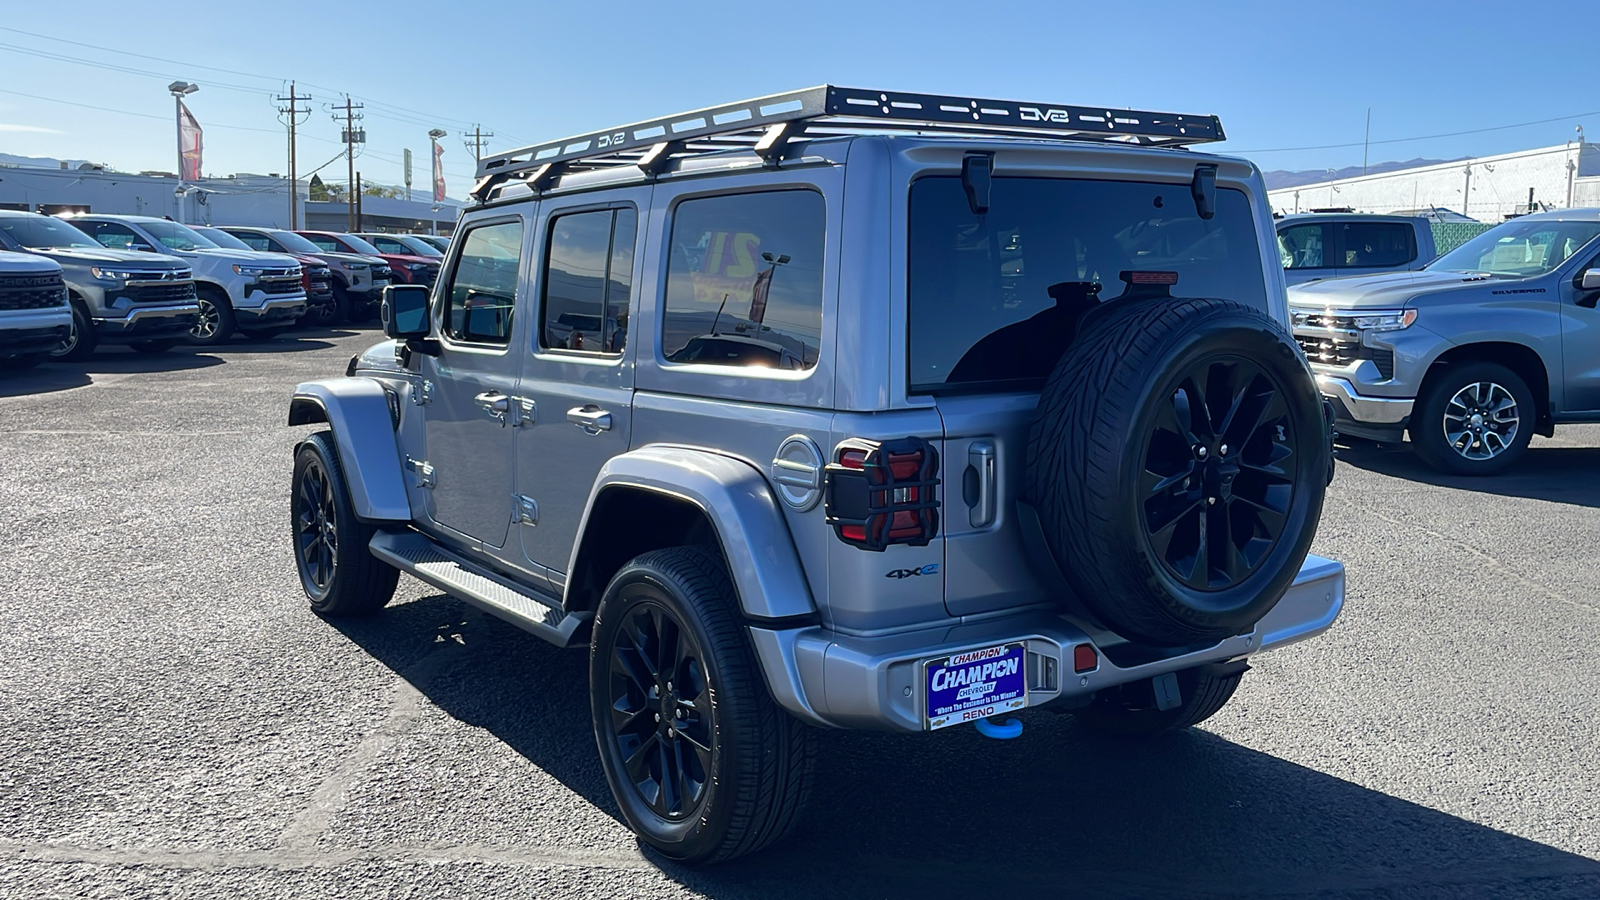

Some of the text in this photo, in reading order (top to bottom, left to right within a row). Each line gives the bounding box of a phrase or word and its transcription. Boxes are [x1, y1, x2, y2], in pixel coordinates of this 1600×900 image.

[1491, 288, 1547, 296] SILVERADO
[952, 647, 1001, 665] CHAMPION
[931, 657, 1019, 692] CHAMPION
[959, 683, 994, 698] CHEVROLET
[962, 698, 986, 709] Customer
[962, 706, 994, 721] RENO
